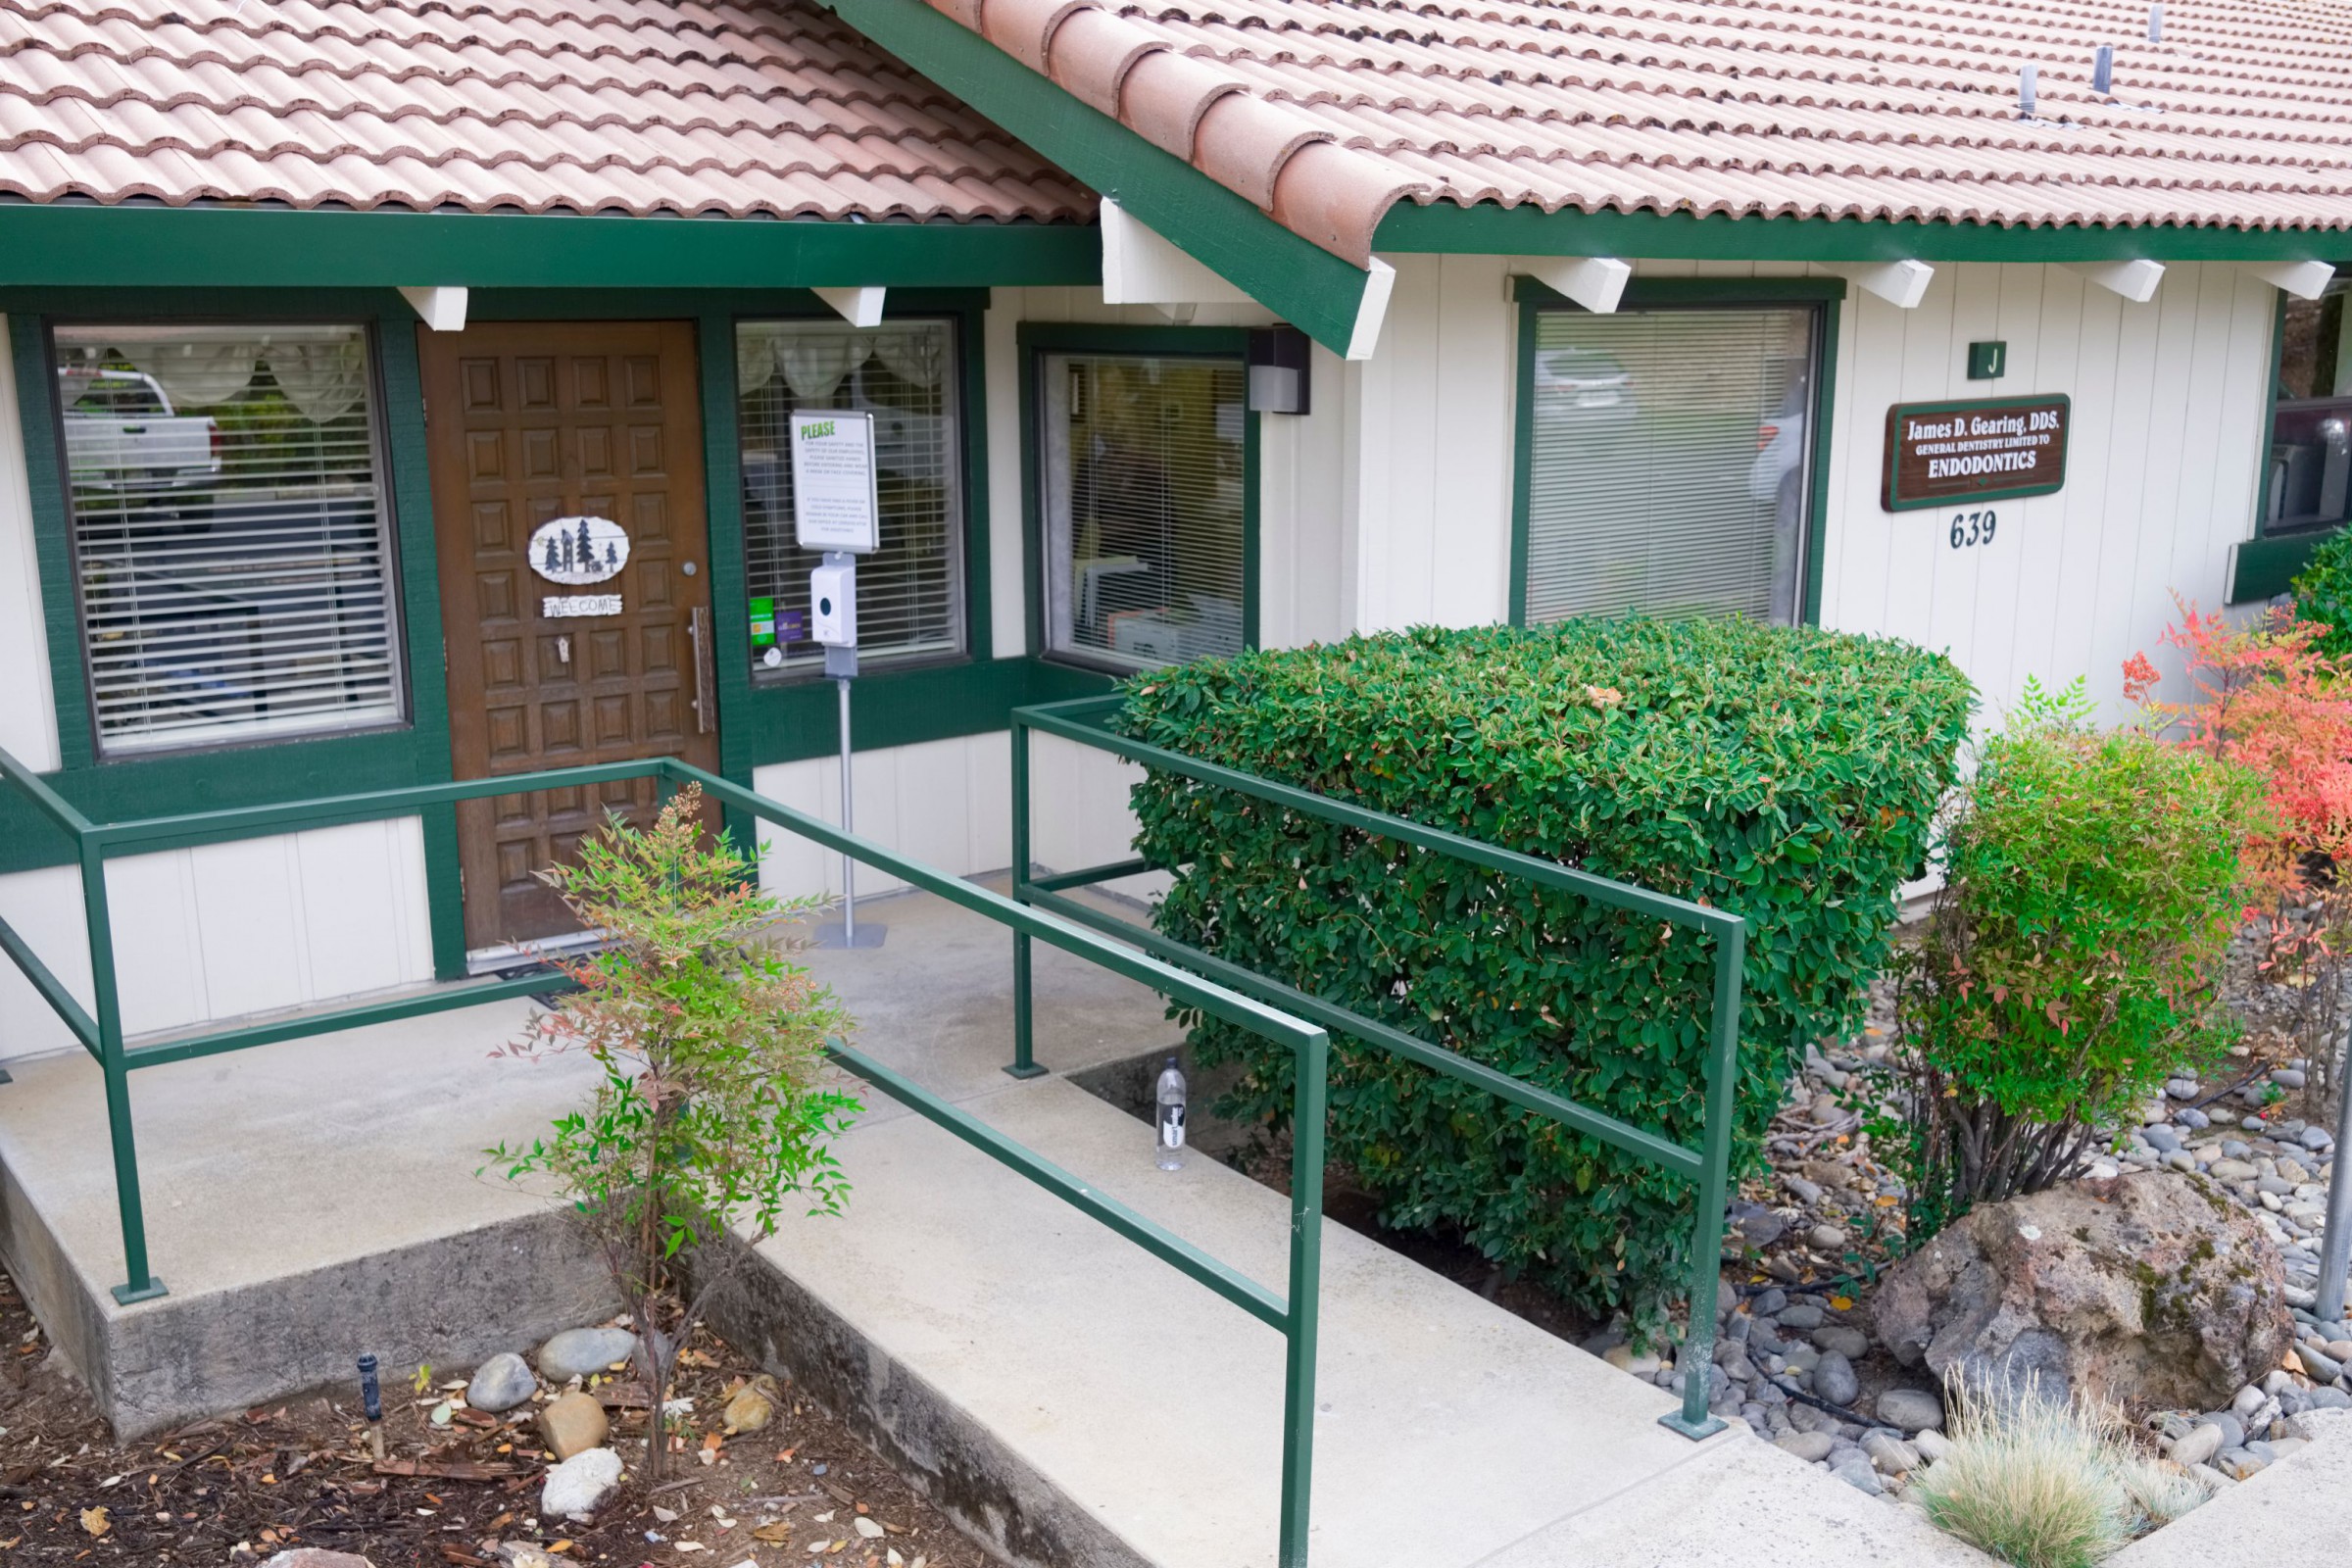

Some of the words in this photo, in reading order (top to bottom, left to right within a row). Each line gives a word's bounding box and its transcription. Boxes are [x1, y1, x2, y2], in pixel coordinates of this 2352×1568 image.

[1987, 347, 1998, 374] J
[801, 420, 836, 441] PLEASE
[1907, 419, 1952, 441] James
[1953, 416, 1969, 437] D.
[2029, 410, 2060, 432] DDS.
[1915, 441, 1957, 456] GENERAL
[1957, 438, 2003, 454] DENTISTRY
[2004, 434, 2038, 449] LIMITED
[2038, 433, 2050, 445] TO
[1928, 450, 2036, 478] ENDODONTICS
[1949, 509, 1997, 550] 639
[550, 597, 617, 616] WELCOME
